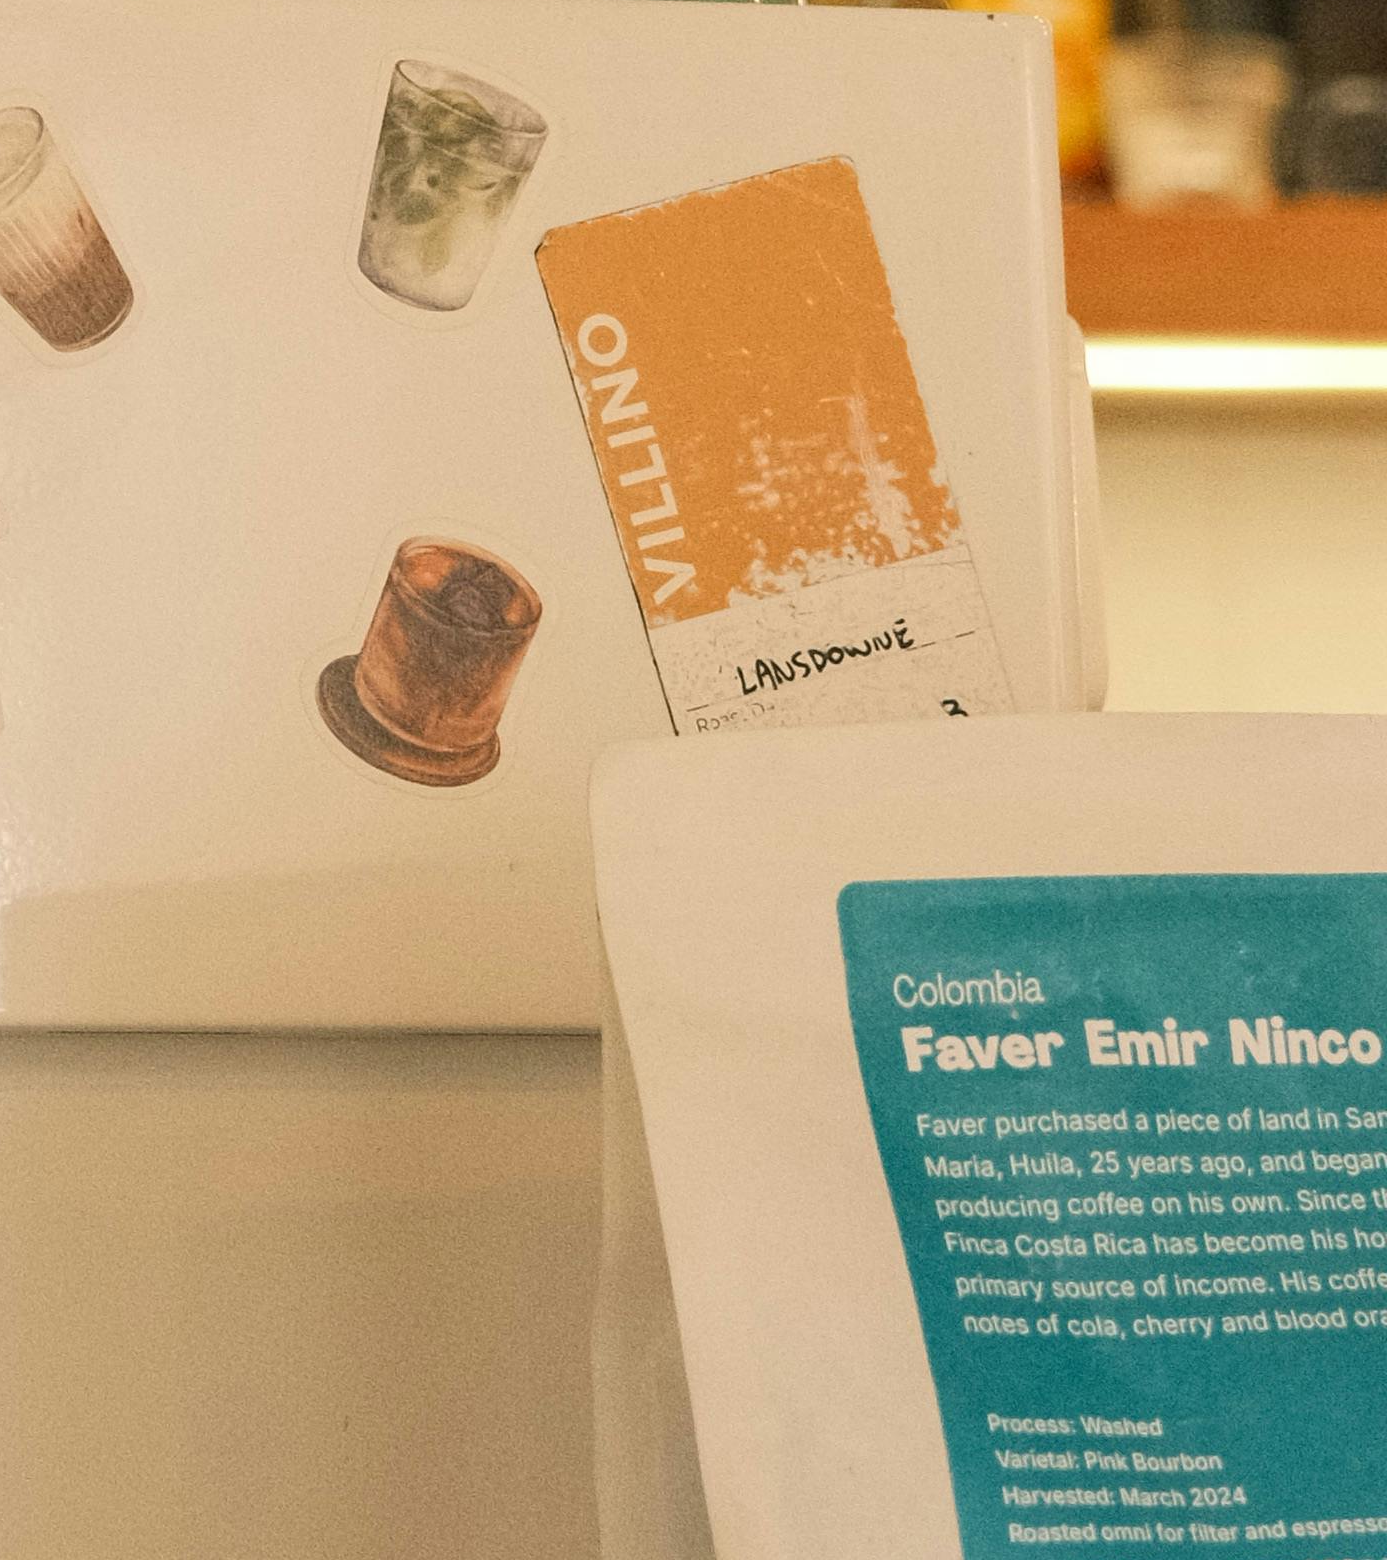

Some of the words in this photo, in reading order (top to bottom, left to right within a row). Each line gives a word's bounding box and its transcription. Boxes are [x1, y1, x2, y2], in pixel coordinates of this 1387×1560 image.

[577, 312, 697, 605] VILLINO
[737, 618, 915, 695] LANSDOWNE
[893, 969, 1046, 1009] Colombia
[901, 1026, 1065, 1072] Faver
[1084, 1017, 1209, 1066] Emir
[1229, 1016, 1382, 1065] Ninco
[917, 1113, 987, 1137] Faver
[995, 1109, 1128, 1139] purchased
[1135, 1113, 1149, 1131] a
[1156, 1109, 1221, 1135] piece
[1227, 1107, 1252, 1131] of
[1259, 1107, 1311, 1131] land
[1317, 1108, 1340, 1129] in
[924, 1155, 1003, 1181] Maria,
[1010, 1153, 1082, 1177] Huila,
[1090, 1150, 1120, 1174] 25
[1127, 1155, 1194, 1179] years
[1200, 1155, 1253, 1179] ago,
[1260, 1151, 1306, 1173] and
[1311, 1150, 1387, 1176] began
[935, 1195, 1061, 1223] producing
[1067, 1192, 1144, 1216] coffee
[1151, 1197, 1182, 1215] on
[1188, 1192, 1225, 1214] his
[1231, 1195, 1290, 1213] own.
[1296, 1189, 1366, 1212] Since
[944, 1231, 1009, 1257] Finca
[1015, 1234, 1088, 1257] Costa
[1093, 1232, 1147, 1255] Rica
[1152, 1233, 1199, 1255] has
[1204, 1233, 1305, 1254] become
[1311, 1229, 1348, 1250] his
[1353, 1227, 1387, 1249] ho
[955, 1274, 1044, 1302] primary
[1052, 1280, 1136, 1299] source
[1143, 1274, 1166, 1297] of
[1174, 1274, 1274, 1296] income.
[1280, 1271, 1322, 1292] His
[964, 1315, 1030, 1335] notes
[1036, 1313, 1059, 1335] of
[1067, 1315, 1126, 1340] cola,
[1133, 1315, 1213, 1338] cherry
[1222, 1310, 1270, 1333] and
[1274, 1308, 1347, 1330] blood
[987, 1413, 1076, 1434] Process:
[1080, 1416, 1163, 1437] Washed
[995, 1450, 1079, 1470] Varietal:
[1084, 1451, 1129, 1470] Pink
[1132, 1452, 1223, 1472] Bourbon
[1002, 1486, 1115, 1507] Harvested:
[1119, 1488, 1186, 1507] March
[1191, 1486, 1247, 1507] 2024
[1008, 1523, 1097, 1543] Roasted
[1100, 1524, 1151, 1542] omni
[1155, 1522, 1185, 1543] for
[1188, 1523, 1239, 1542] filter
[1245, 1520, 1287, 1540] and
[1291, 1517, 1387, 1540] espresso
